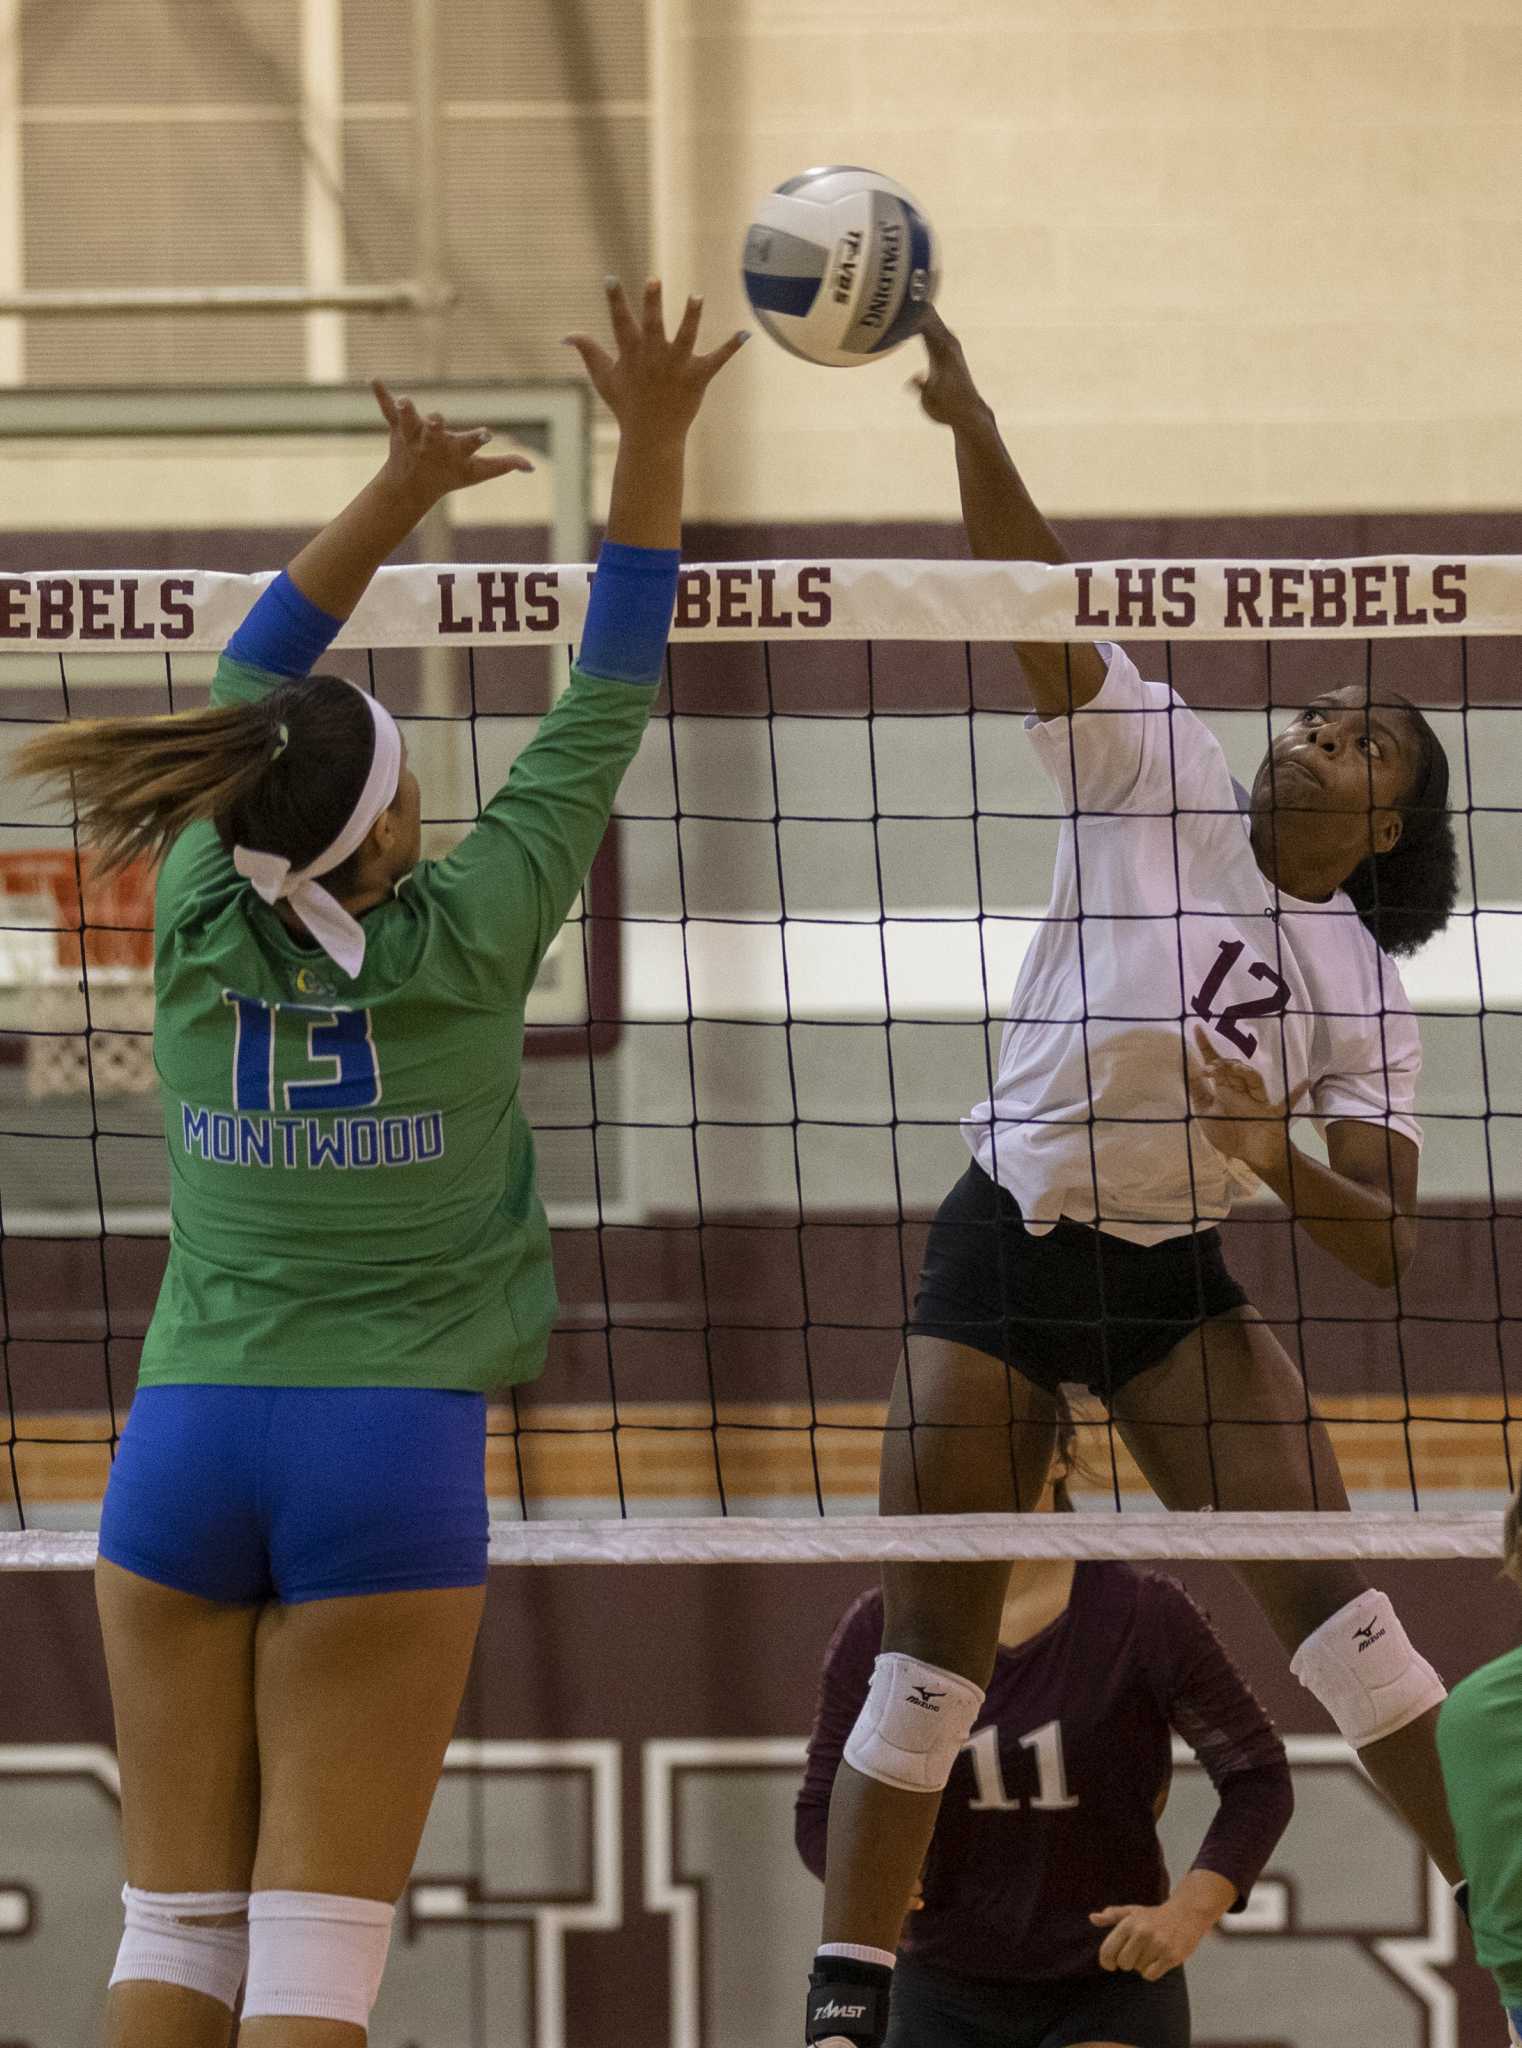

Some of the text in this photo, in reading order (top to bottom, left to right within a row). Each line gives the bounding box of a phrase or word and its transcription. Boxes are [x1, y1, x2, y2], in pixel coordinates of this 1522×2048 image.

[437, 567, 832, 634] LHS BELS
[1074, 564, 1467, 627] LHS REBELS
[1190, 939, 1292, 1060] 12
[221, 987, 383, 1112] 13
[180, 1100, 444, 1170] MONTWOOD
[958, 1719, 1080, 1811] 11
